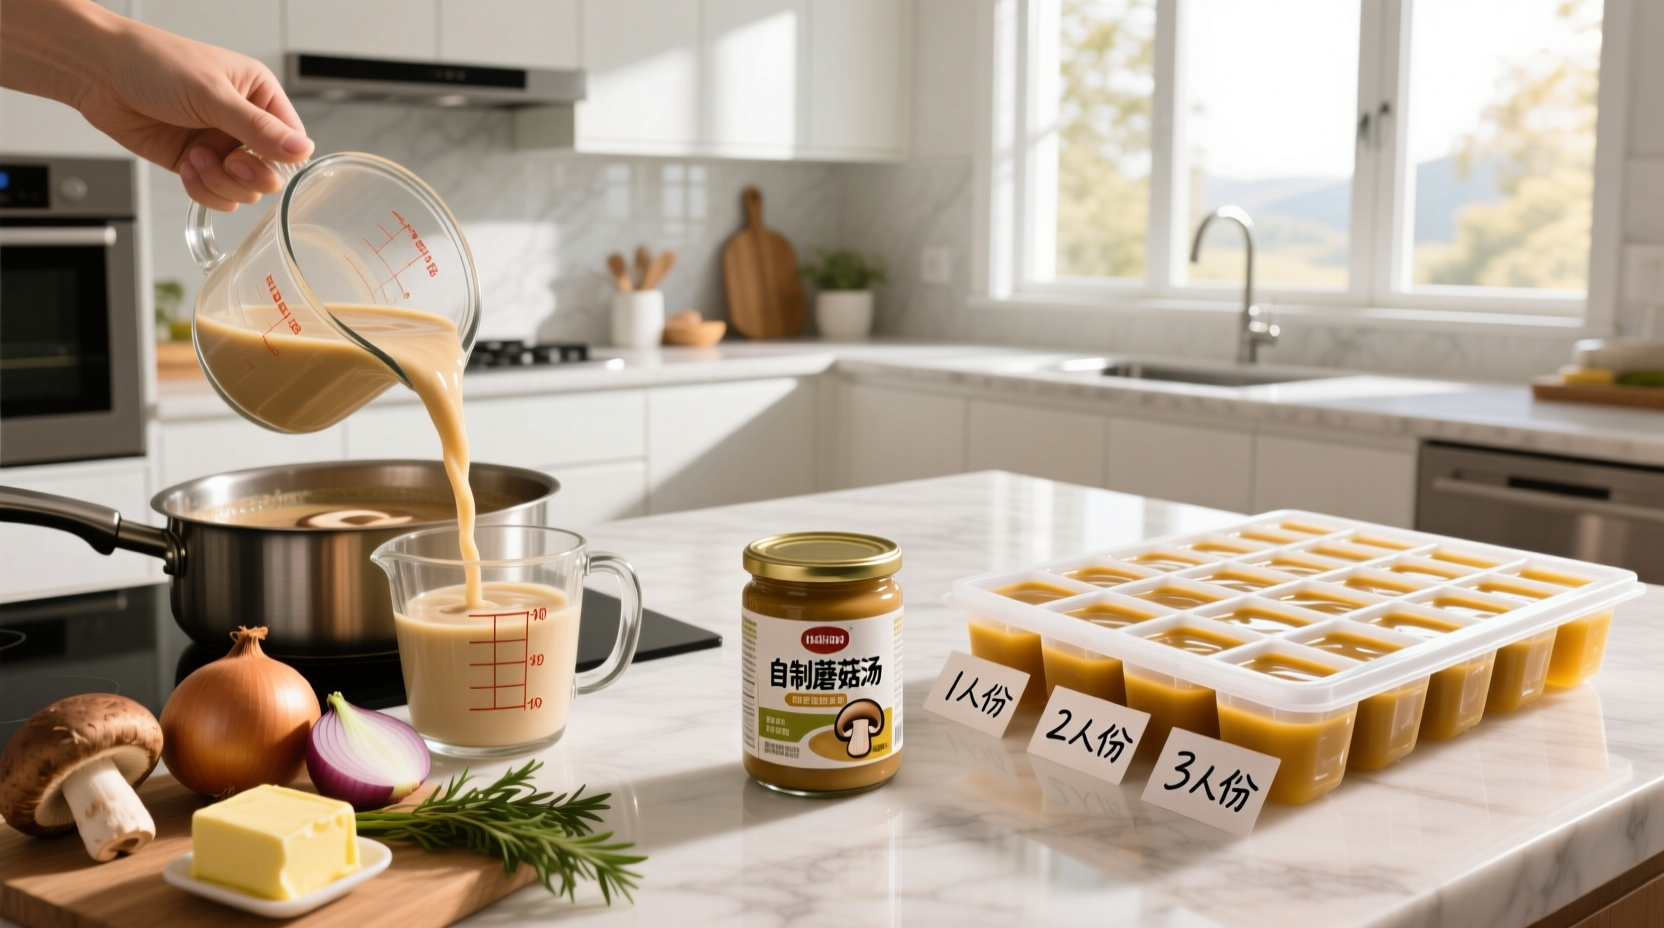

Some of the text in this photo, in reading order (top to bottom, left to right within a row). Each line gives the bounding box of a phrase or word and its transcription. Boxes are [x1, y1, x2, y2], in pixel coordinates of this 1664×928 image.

[770, 656, 882, 690] 自制蘑菇汤
[945, 670, 1013, 718] 1人份
[1045, 709, 1133, 763] 2人份
[1163, 750, 1259, 813] 3人份
